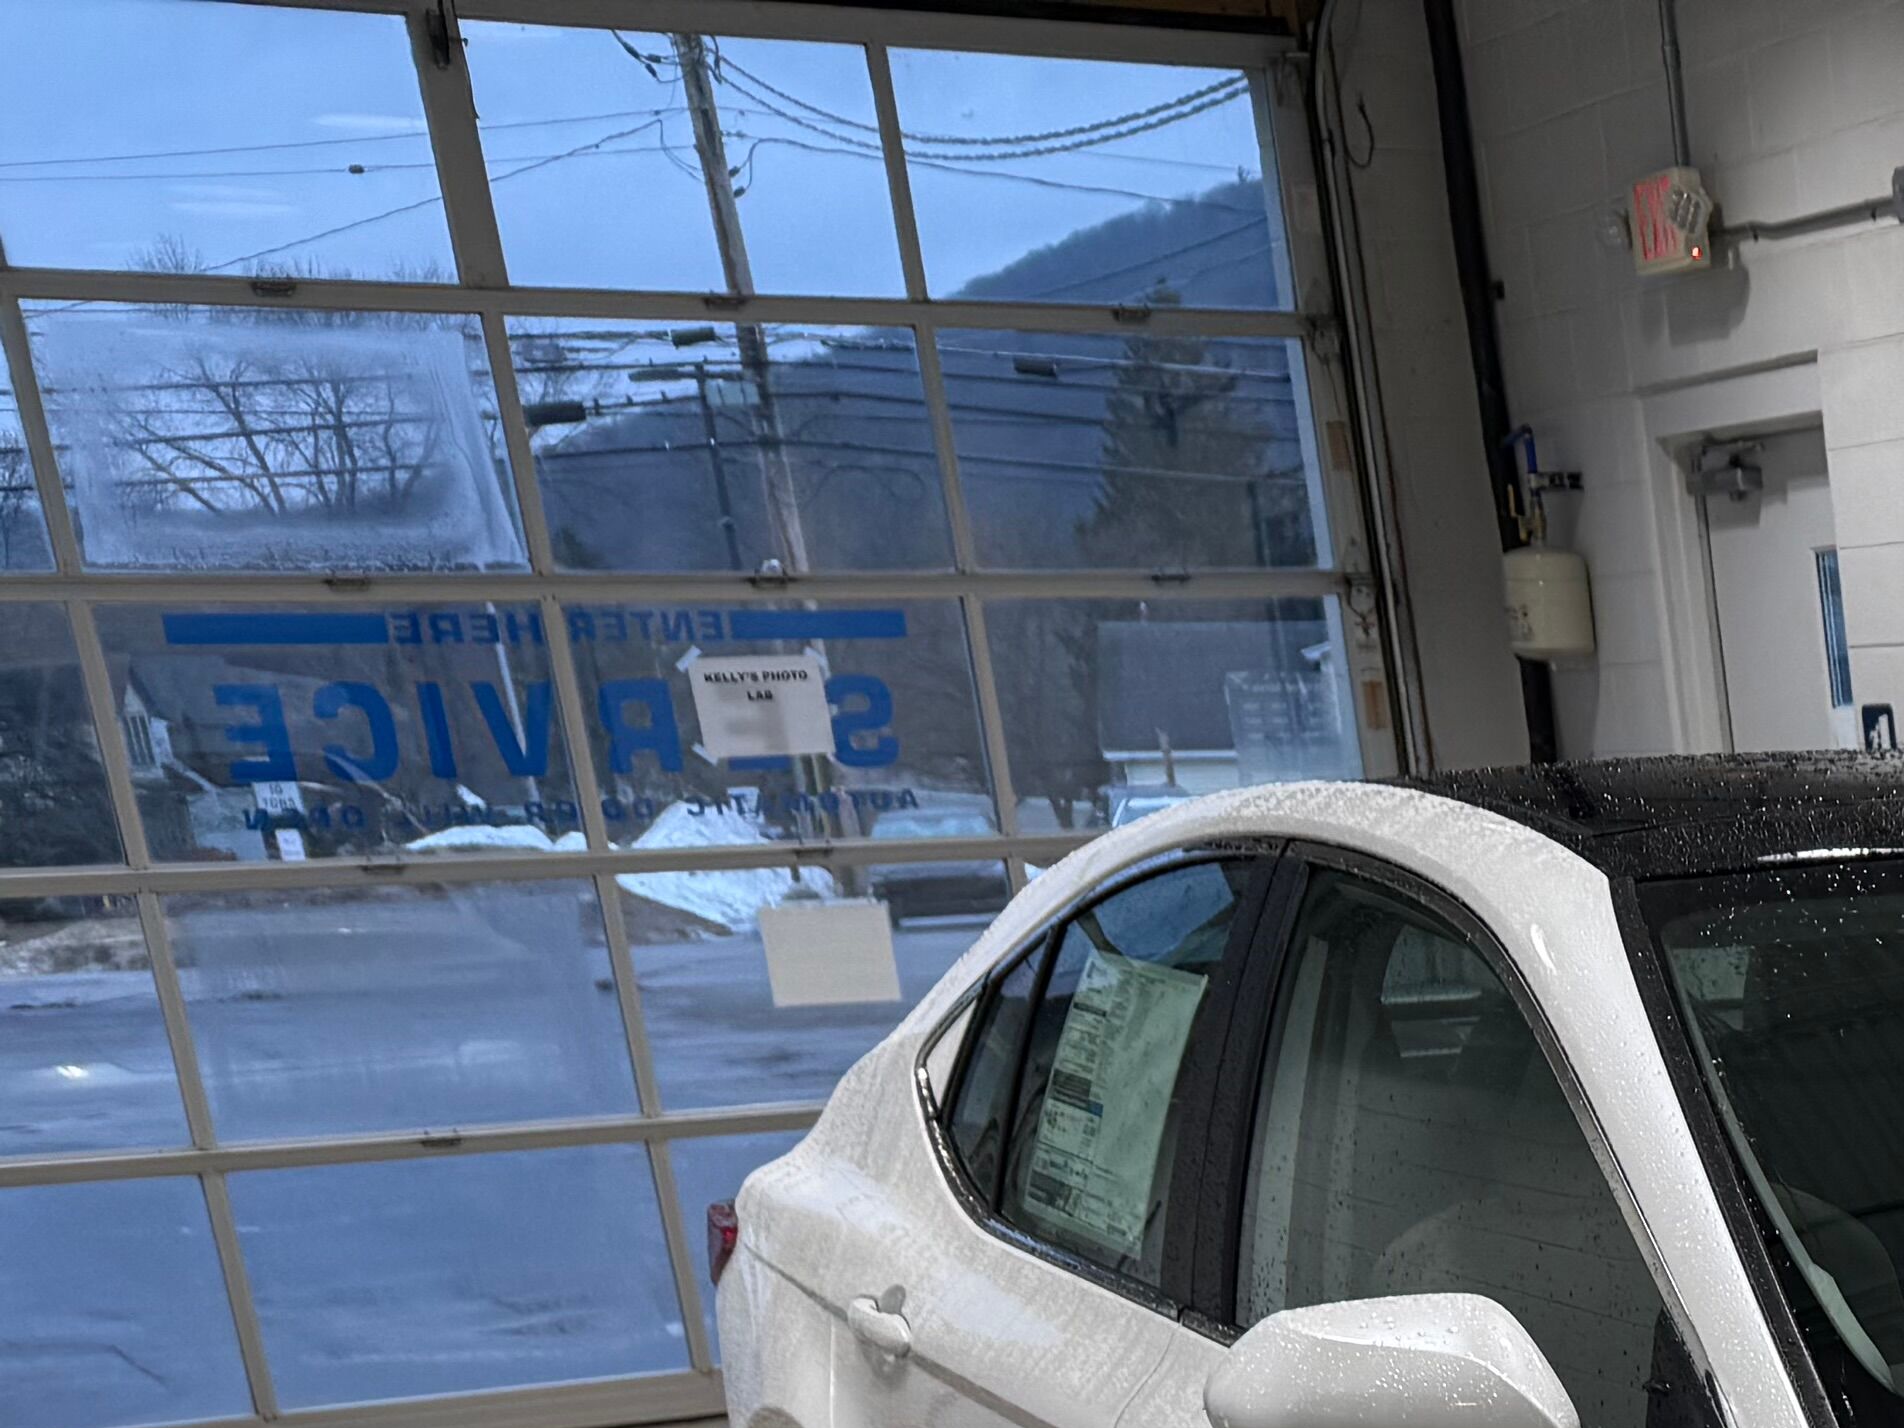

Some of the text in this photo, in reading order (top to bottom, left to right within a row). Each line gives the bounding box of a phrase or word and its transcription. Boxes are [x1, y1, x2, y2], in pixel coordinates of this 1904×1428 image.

[704, 669, 808, 683] KELLY'S PHOTO
[746, 690, 774, 701] LAB
